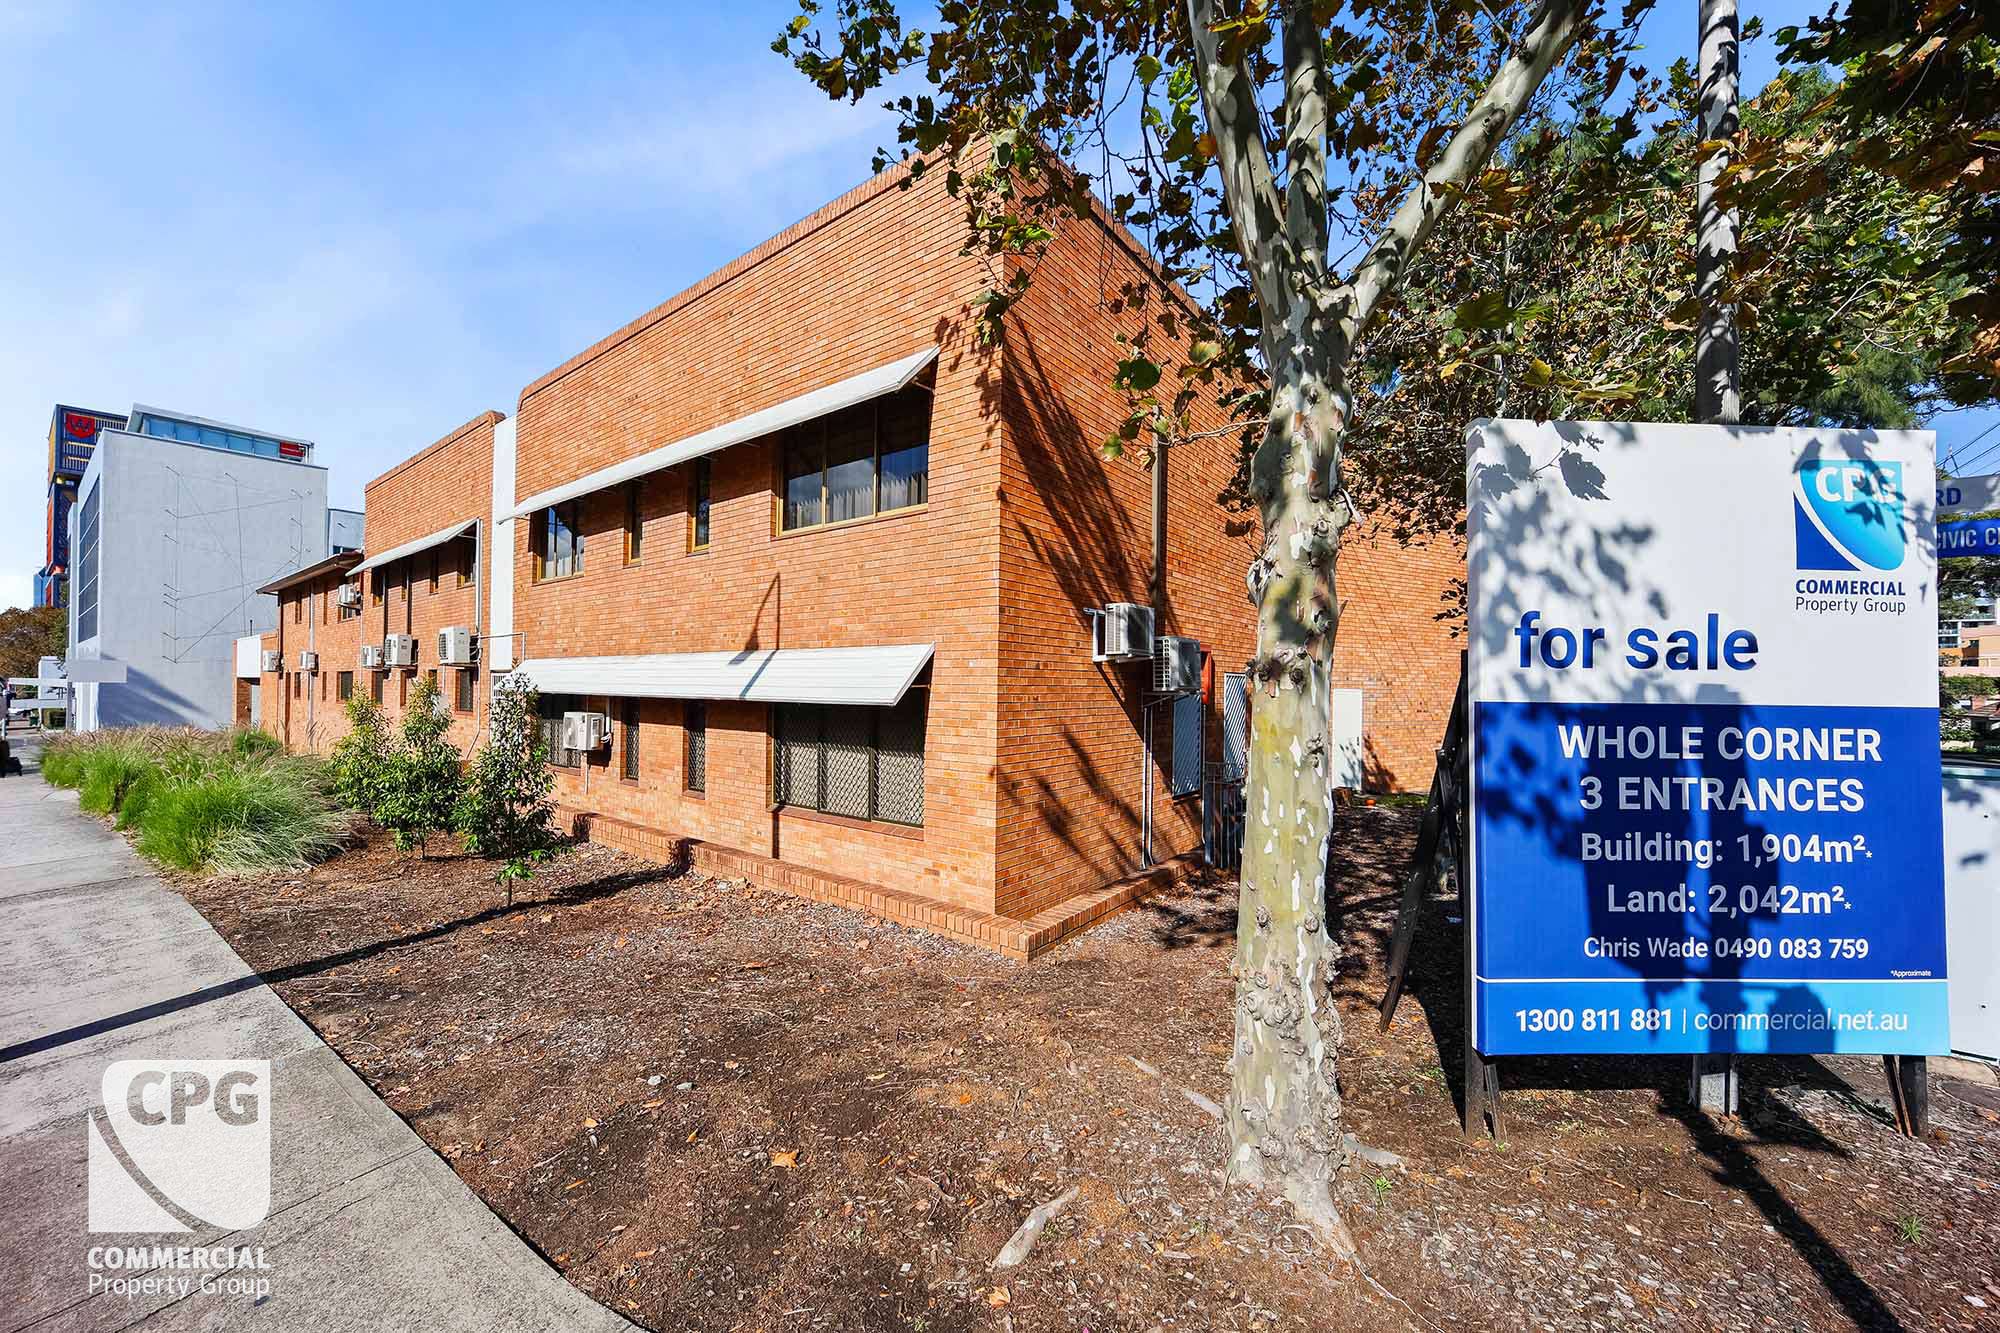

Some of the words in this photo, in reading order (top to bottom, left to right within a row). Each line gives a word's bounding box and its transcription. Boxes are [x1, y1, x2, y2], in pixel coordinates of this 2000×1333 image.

[1814, 466, 1898, 504] CPG
[1985, 527, 2000, 546] C
[1795, 579, 1906, 597] COMMERCIAL
[1796, 597, 1858, 615] Property
[1863, 597, 1906, 615] Group
[1514, 610, 1605, 669] for
[1626, 613, 1760, 671] sale
[1558, 725, 1704, 760] WHOLE
[1717, 727, 1882, 761] CORNER
[1580, 777, 1602, 810] 3
[1618, 777, 1865, 812] ENTRANCES
[1581, 833, 1724, 869] Building:
[1608, 884, 1697, 913] Land:
[1584, 937, 1640, 959] Chris
[1647, 938, 1708, 959] Wade
[1715, 938, 1772, 960] 0490
[1779, 939, 1822, 960] 083
[1829, 940, 1869, 960] 759
[1515, 1009, 1574, 1032] 1300
[1581, 1009, 1622, 1032] 811
[1630, 1009, 1672, 1032] 881
[1694, 1008, 1908, 1032] commercial.net.au
